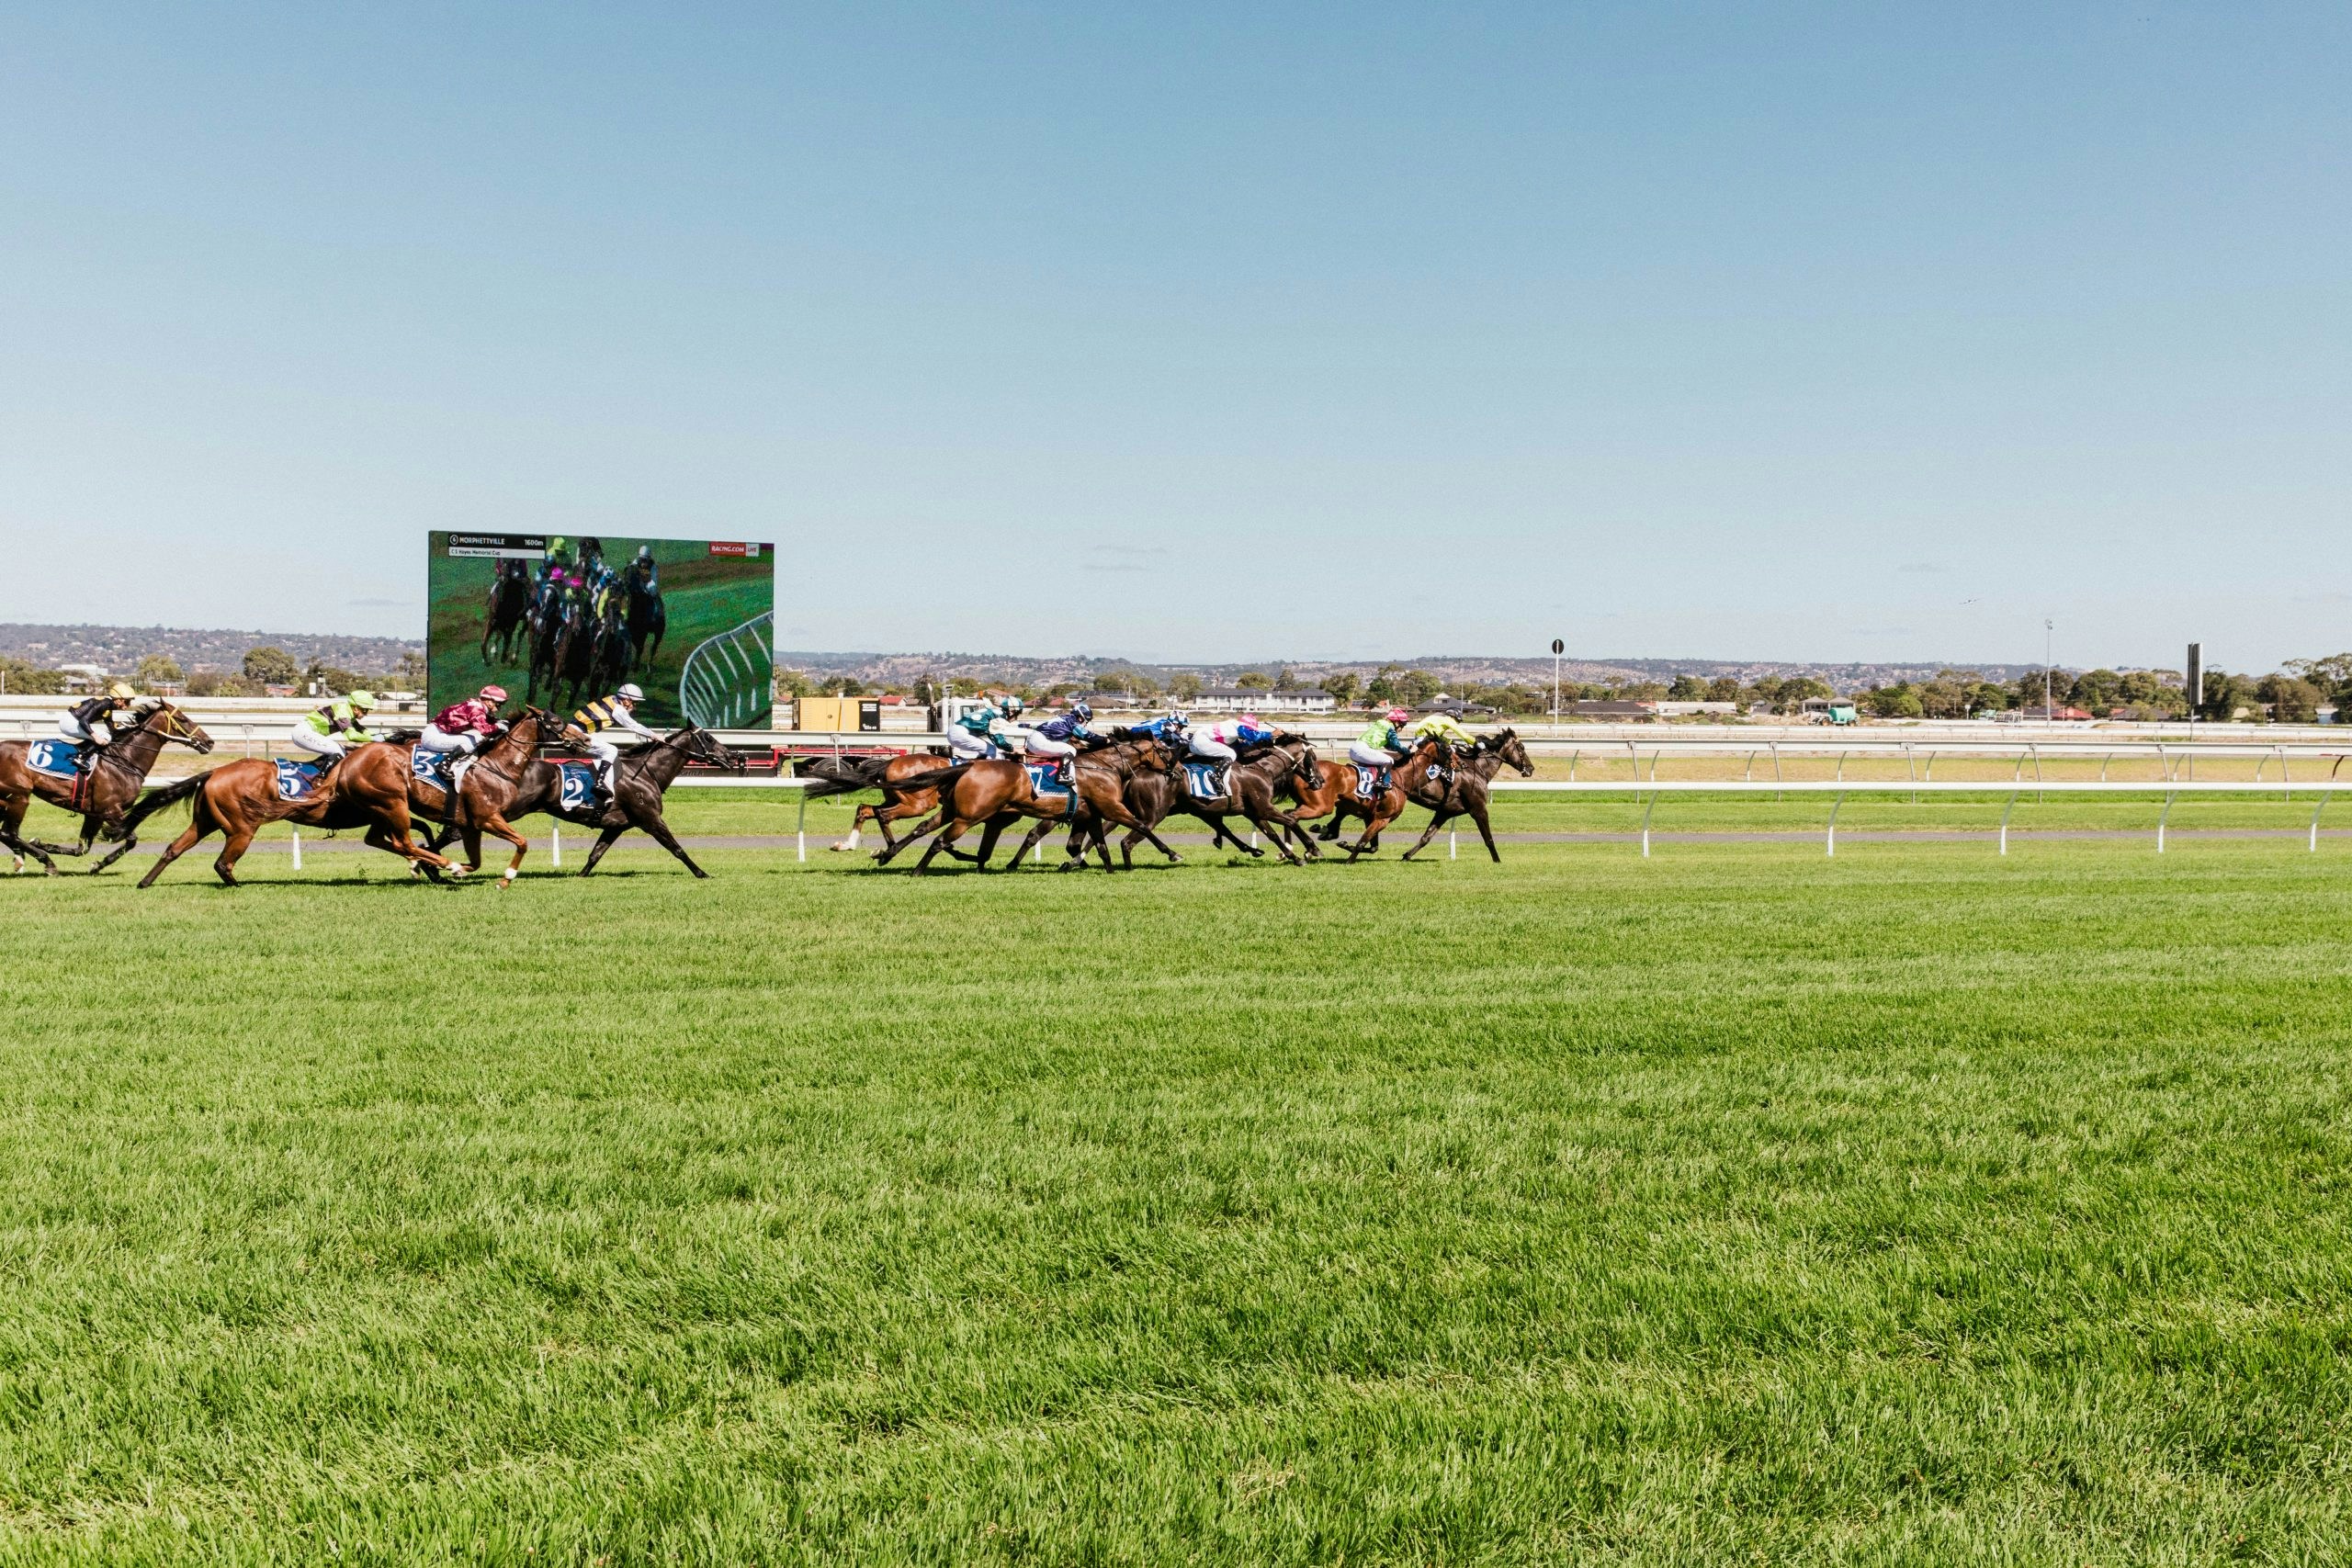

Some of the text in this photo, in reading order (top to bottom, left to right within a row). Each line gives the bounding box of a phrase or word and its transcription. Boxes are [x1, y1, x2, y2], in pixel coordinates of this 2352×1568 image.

[459, 536, 505, 545] MORPHETTVILLE
[524, 538, 544, 547] 1600m
[29, 742, 53, 768] 6
[413, 750, 435, 776] 3
[279, 767, 301, 795] 5
[561, 777, 584, 807] 2
[1026, 766, 1045, 792] 7
[1192, 770, 1220, 797] 10
[1358, 771, 1374, 794] 8
